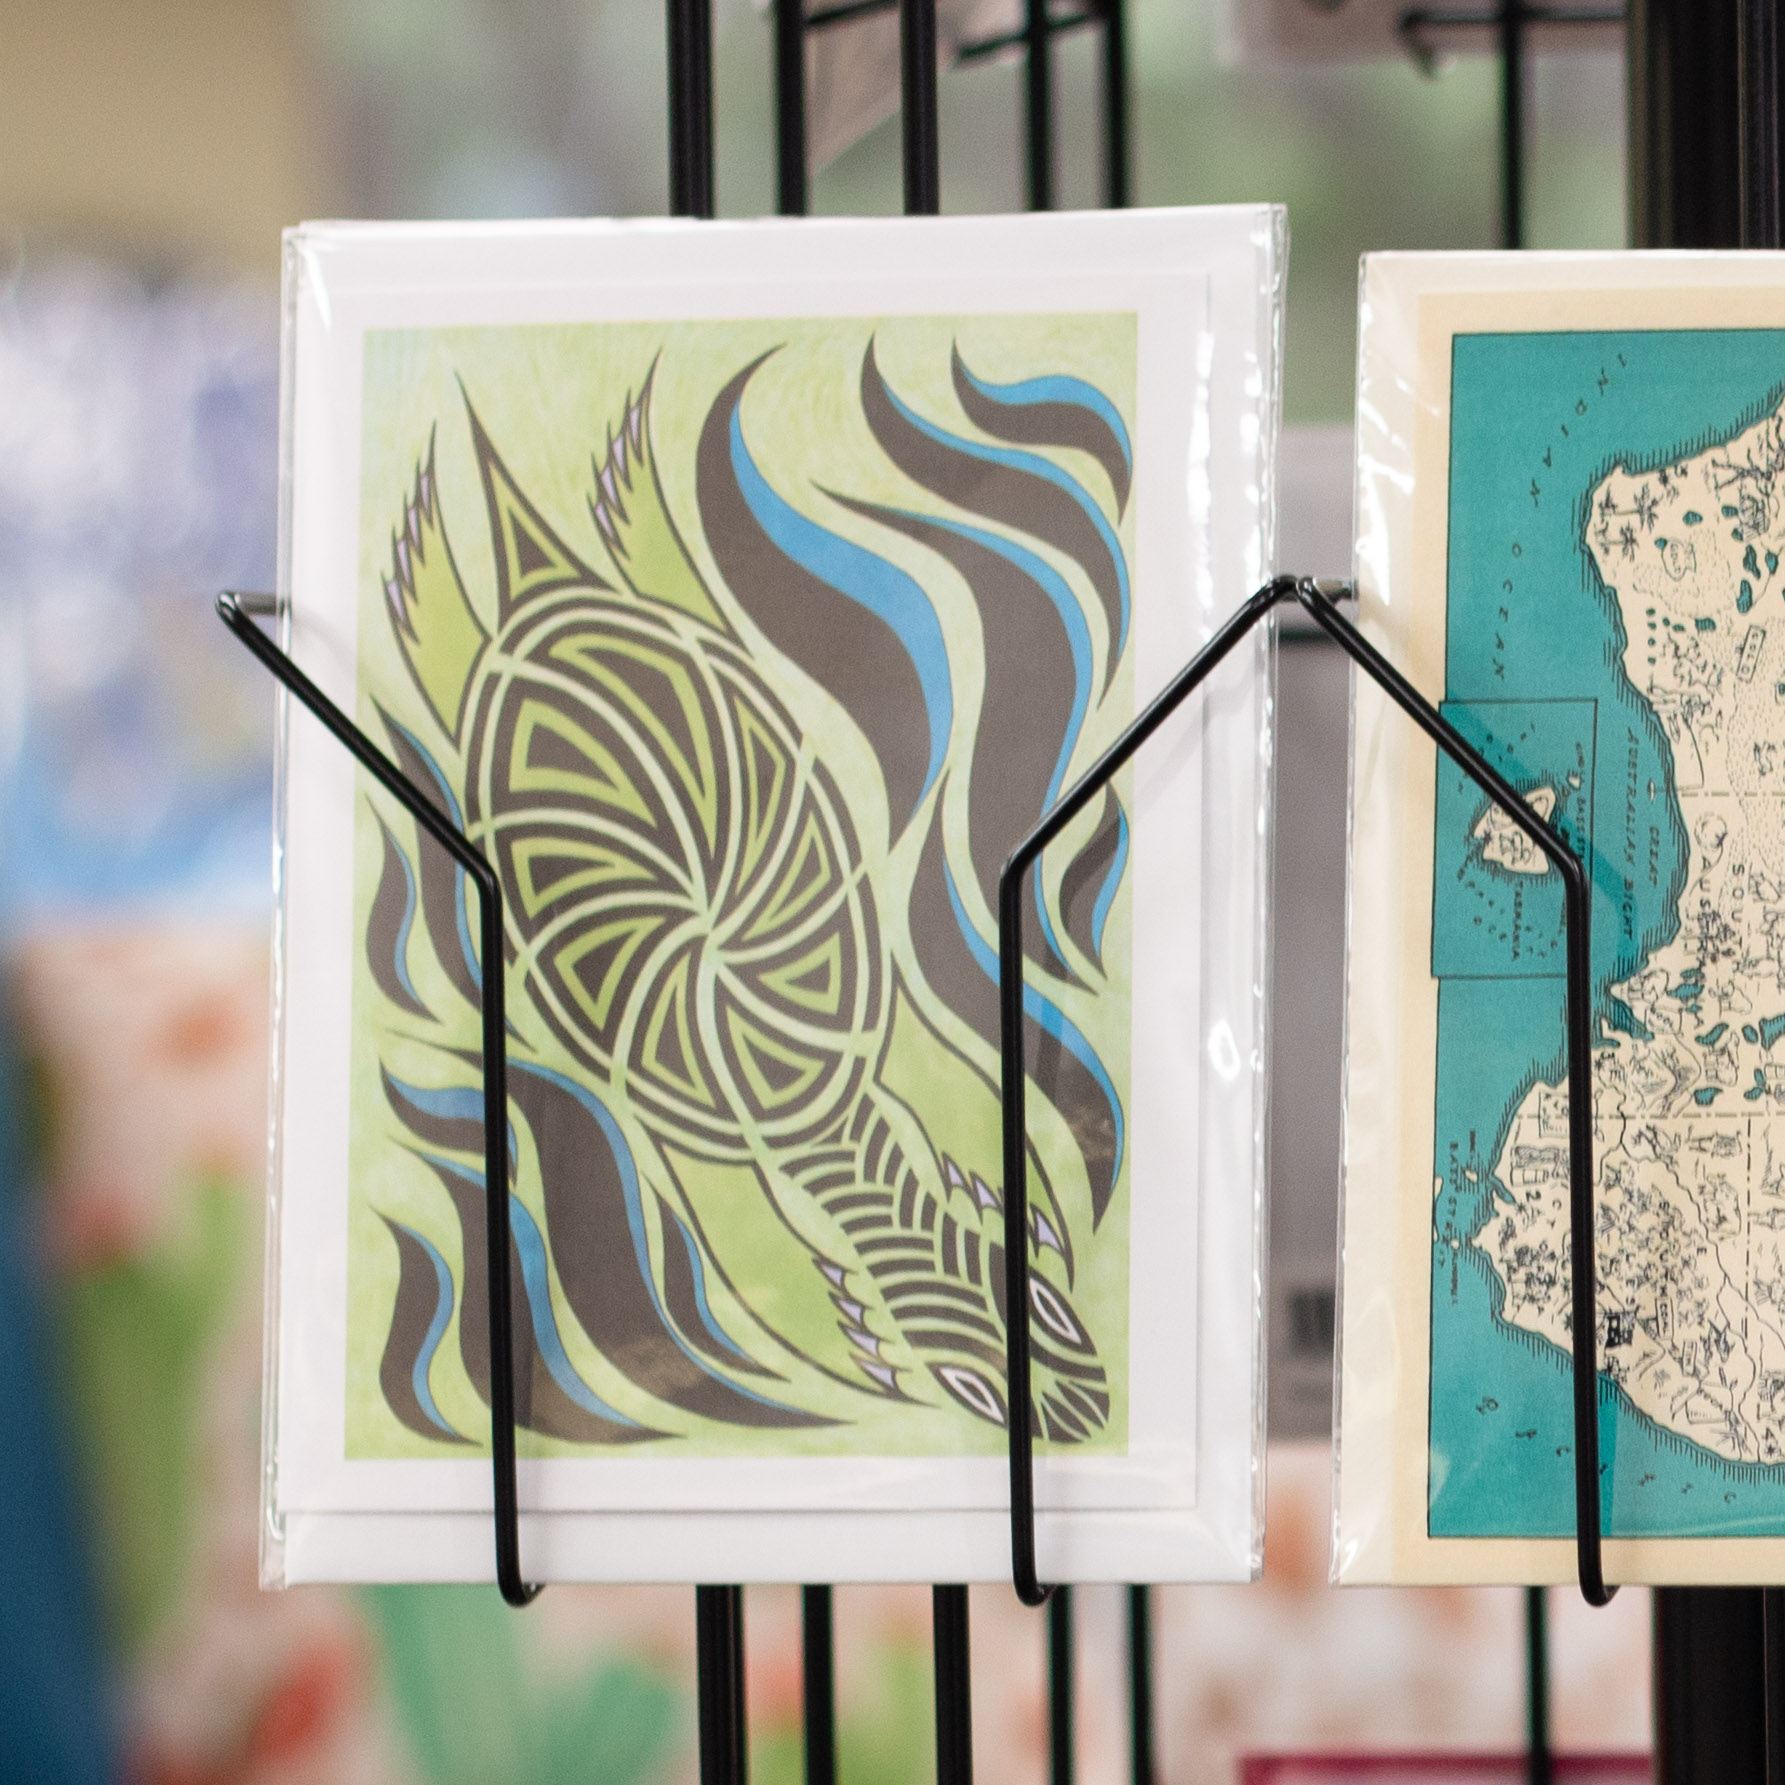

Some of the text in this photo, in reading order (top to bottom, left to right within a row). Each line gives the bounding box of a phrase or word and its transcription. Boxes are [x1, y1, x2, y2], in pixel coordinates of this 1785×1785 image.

[1624, 727, 1639, 867] AUSTRALIAN
[1648, 825, 1660, 887] GREAT
[1660, 1302, 1670, 1334] COAL
